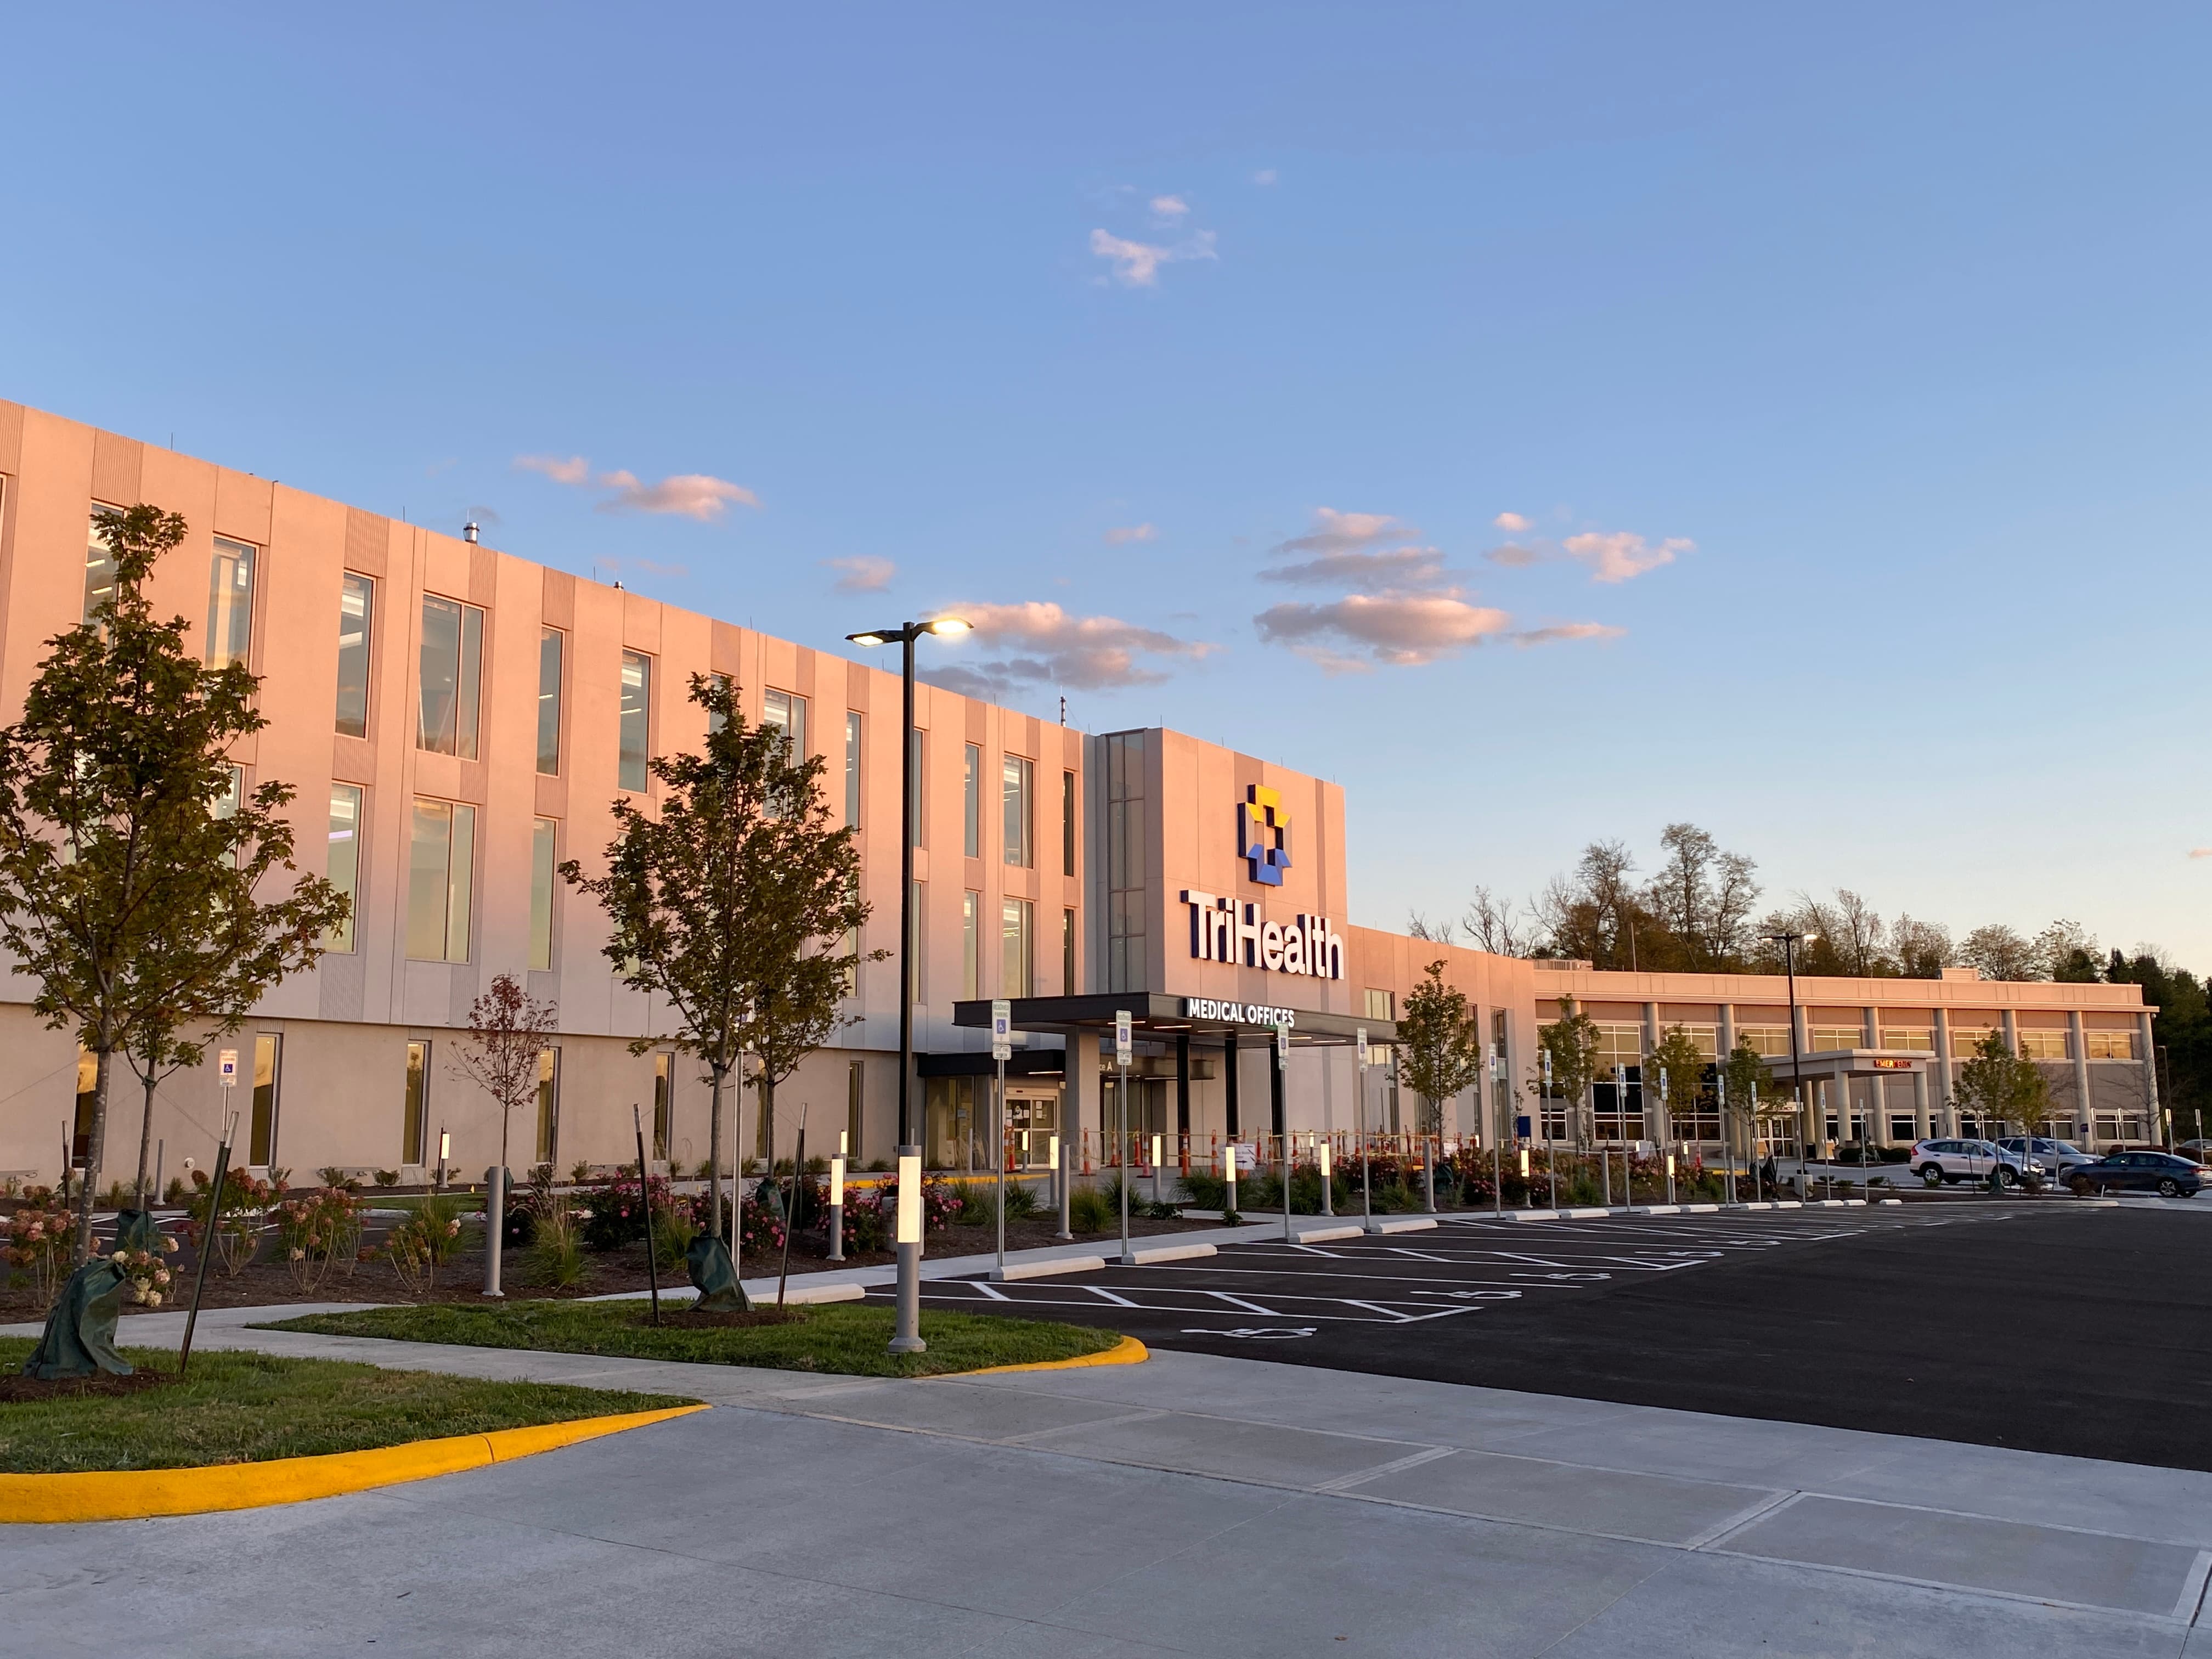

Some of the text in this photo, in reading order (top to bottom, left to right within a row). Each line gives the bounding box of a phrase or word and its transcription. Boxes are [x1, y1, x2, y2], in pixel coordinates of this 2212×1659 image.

[1181, 889, 1344, 980] TriHealth
[1188, 998, 1295, 1028] MEDICAL OFFICES
[1107, 1060, 1113, 1071] A
